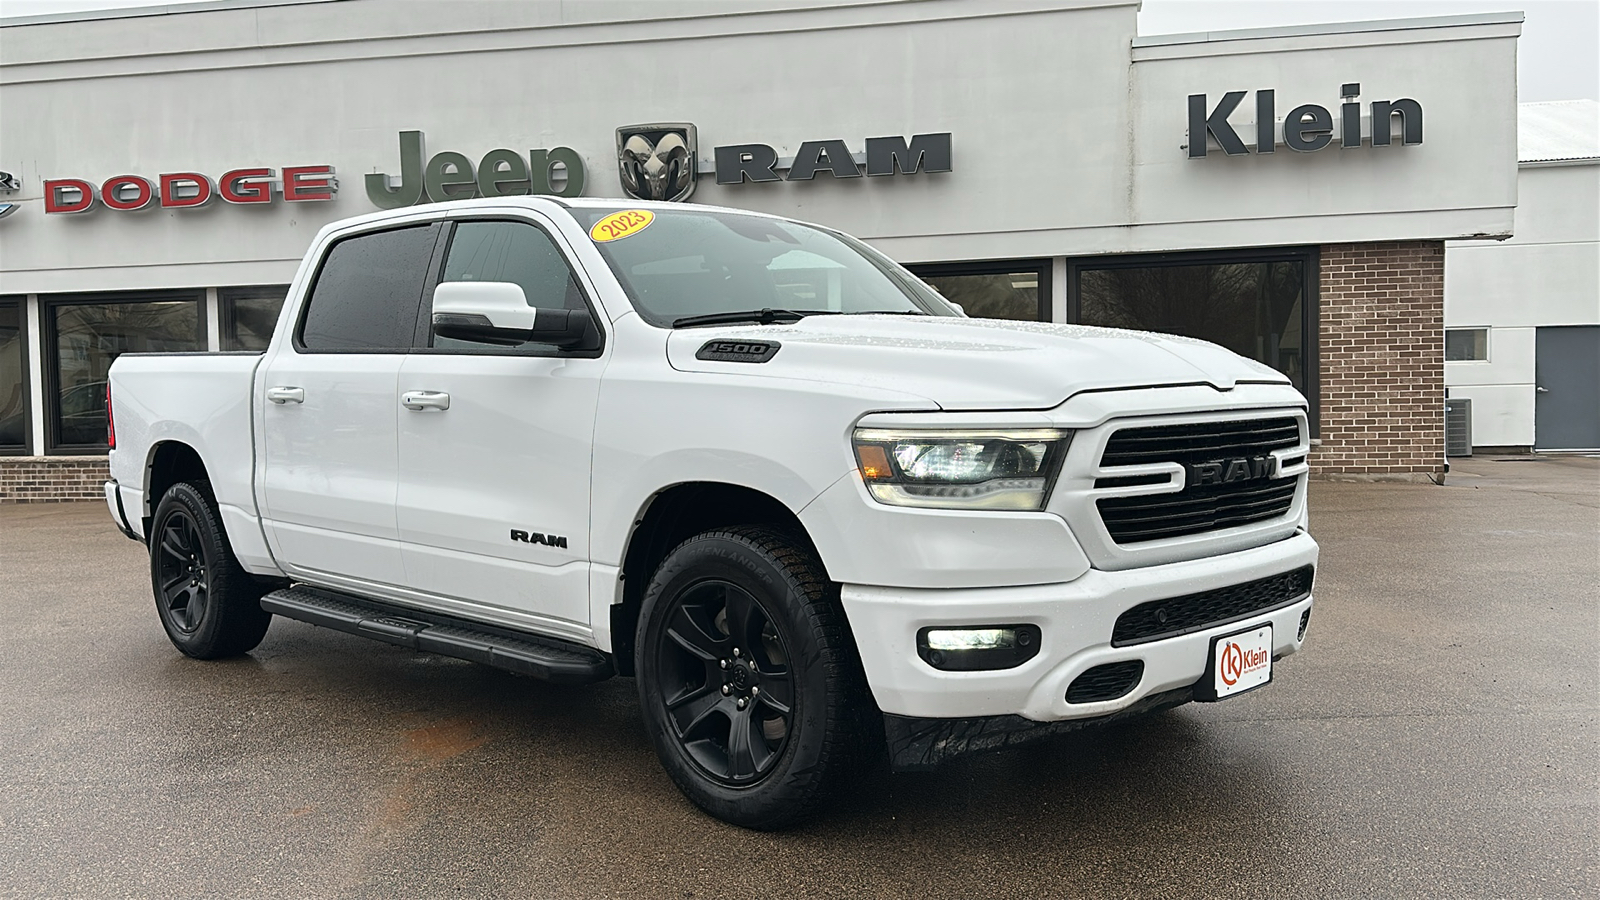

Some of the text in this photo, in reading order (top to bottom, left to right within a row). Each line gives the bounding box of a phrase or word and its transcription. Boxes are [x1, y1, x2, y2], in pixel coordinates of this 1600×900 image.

[1187, 83, 1423, 159] Klein
[364, 130, 588, 210] Jeep
[714, 132, 953, 185] RAM
[43, 165, 337, 214] DODGE
[601, 211, 646, 238] 2023
[710, 343, 767, 354] 1500
[1190, 455, 1277, 487] RAM
[510, 528, 568, 550] RAM
[1243, 646, 1268, 670] Klein
